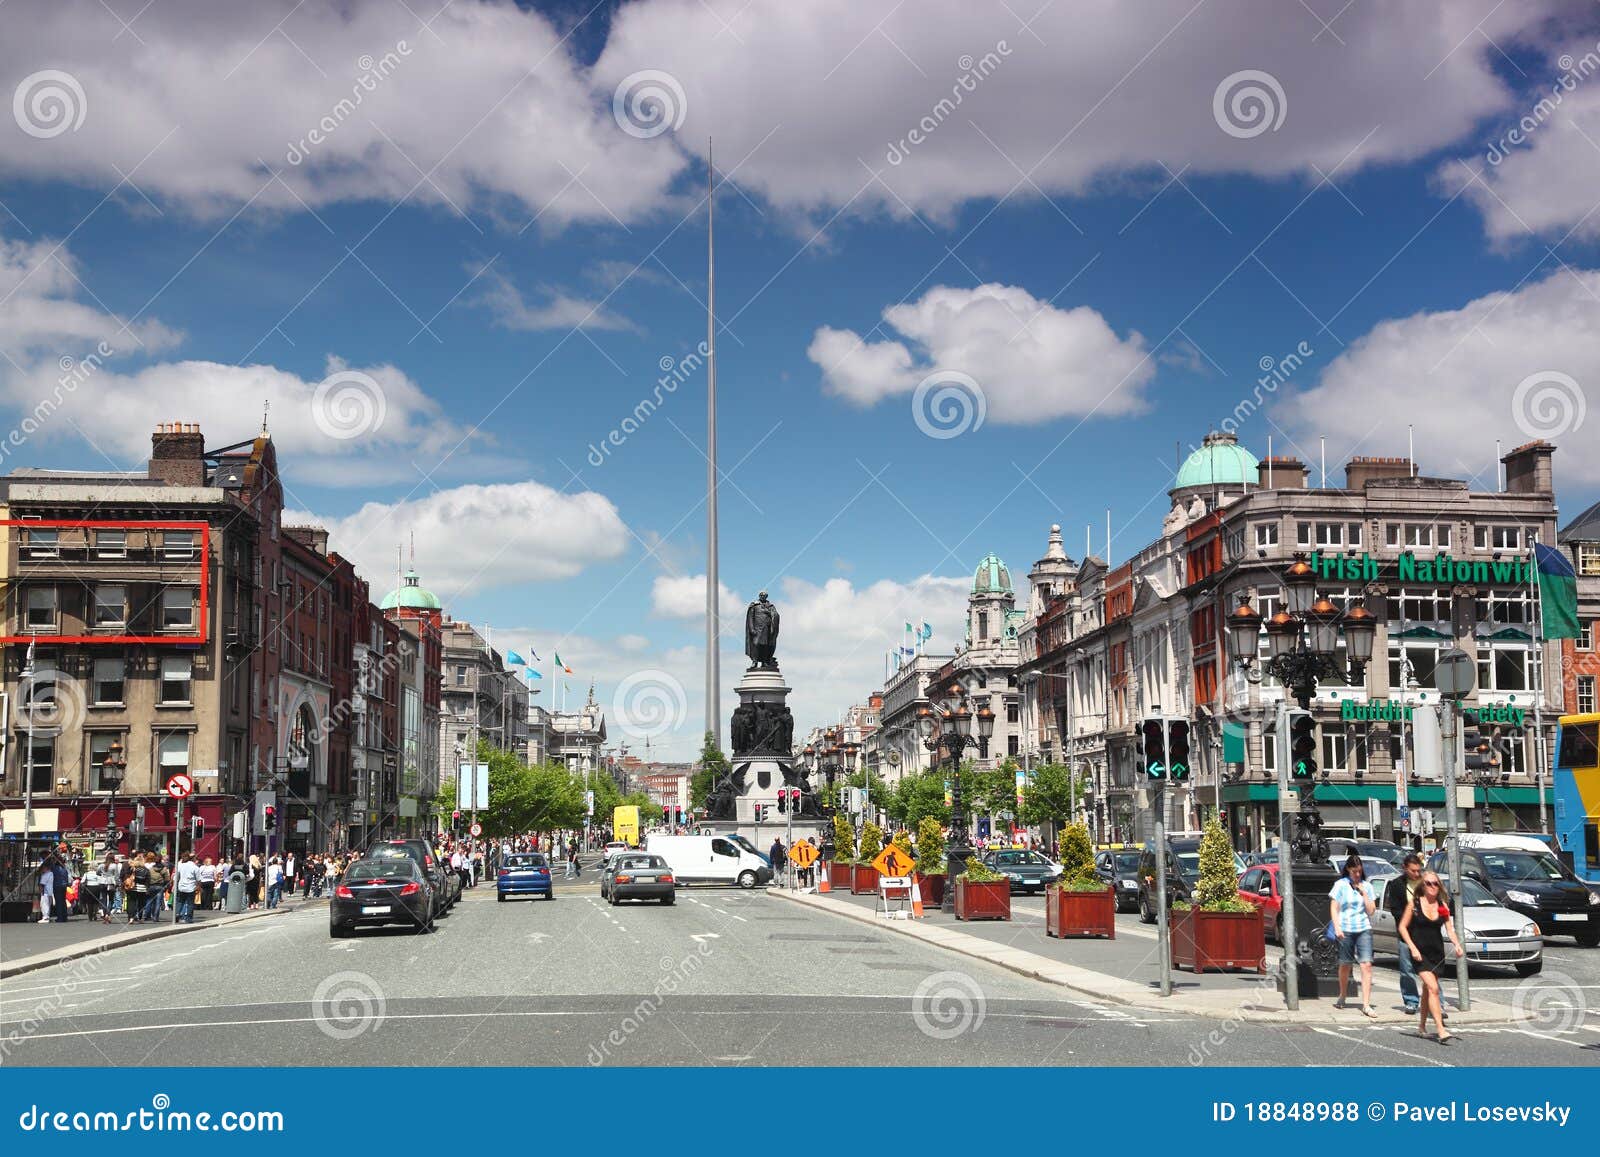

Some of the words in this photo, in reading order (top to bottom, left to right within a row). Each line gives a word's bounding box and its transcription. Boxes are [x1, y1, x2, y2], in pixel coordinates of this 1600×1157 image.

[1311, 552, 1378, 580] Irish
[1399, 554, 1539, 584] Nationwid
[1342, 698, 1413, 721] Buildin
[1456, 699, 1525, 727] ciety
